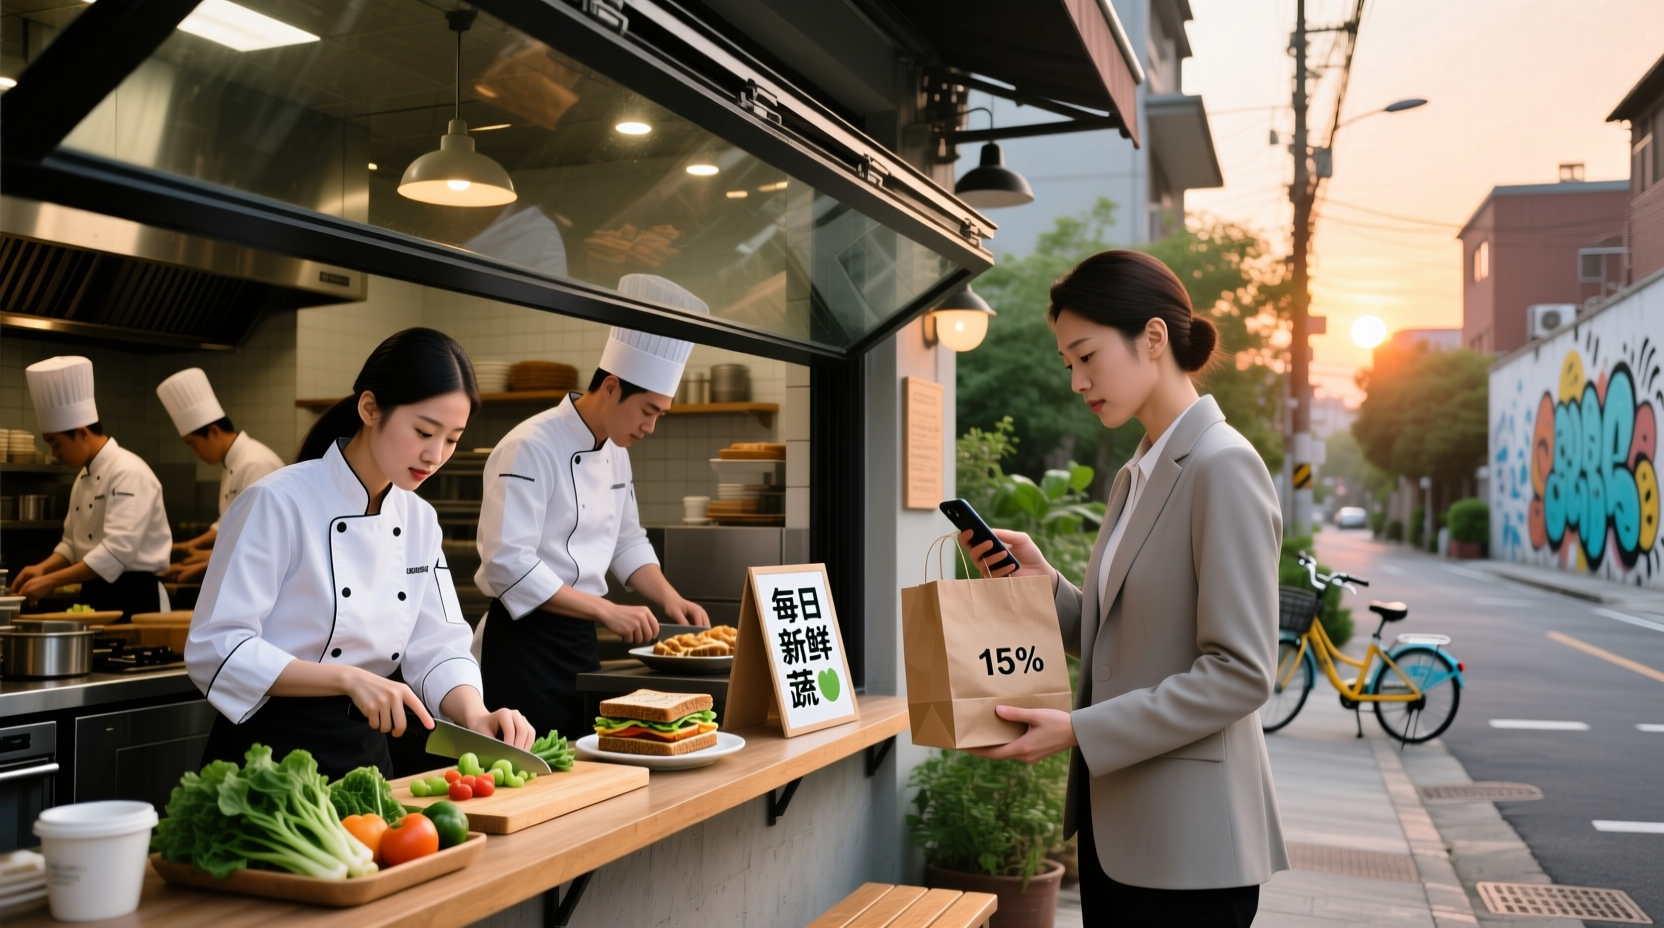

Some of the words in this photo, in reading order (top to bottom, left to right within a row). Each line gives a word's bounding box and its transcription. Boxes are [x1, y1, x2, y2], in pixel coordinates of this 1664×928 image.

[772, 587, 821, 623] 每日
[778, 625, 833, 665] 新鲜
[979, 645, 1045, 675] 15%
[787, 669, 820, 708] 蔬
